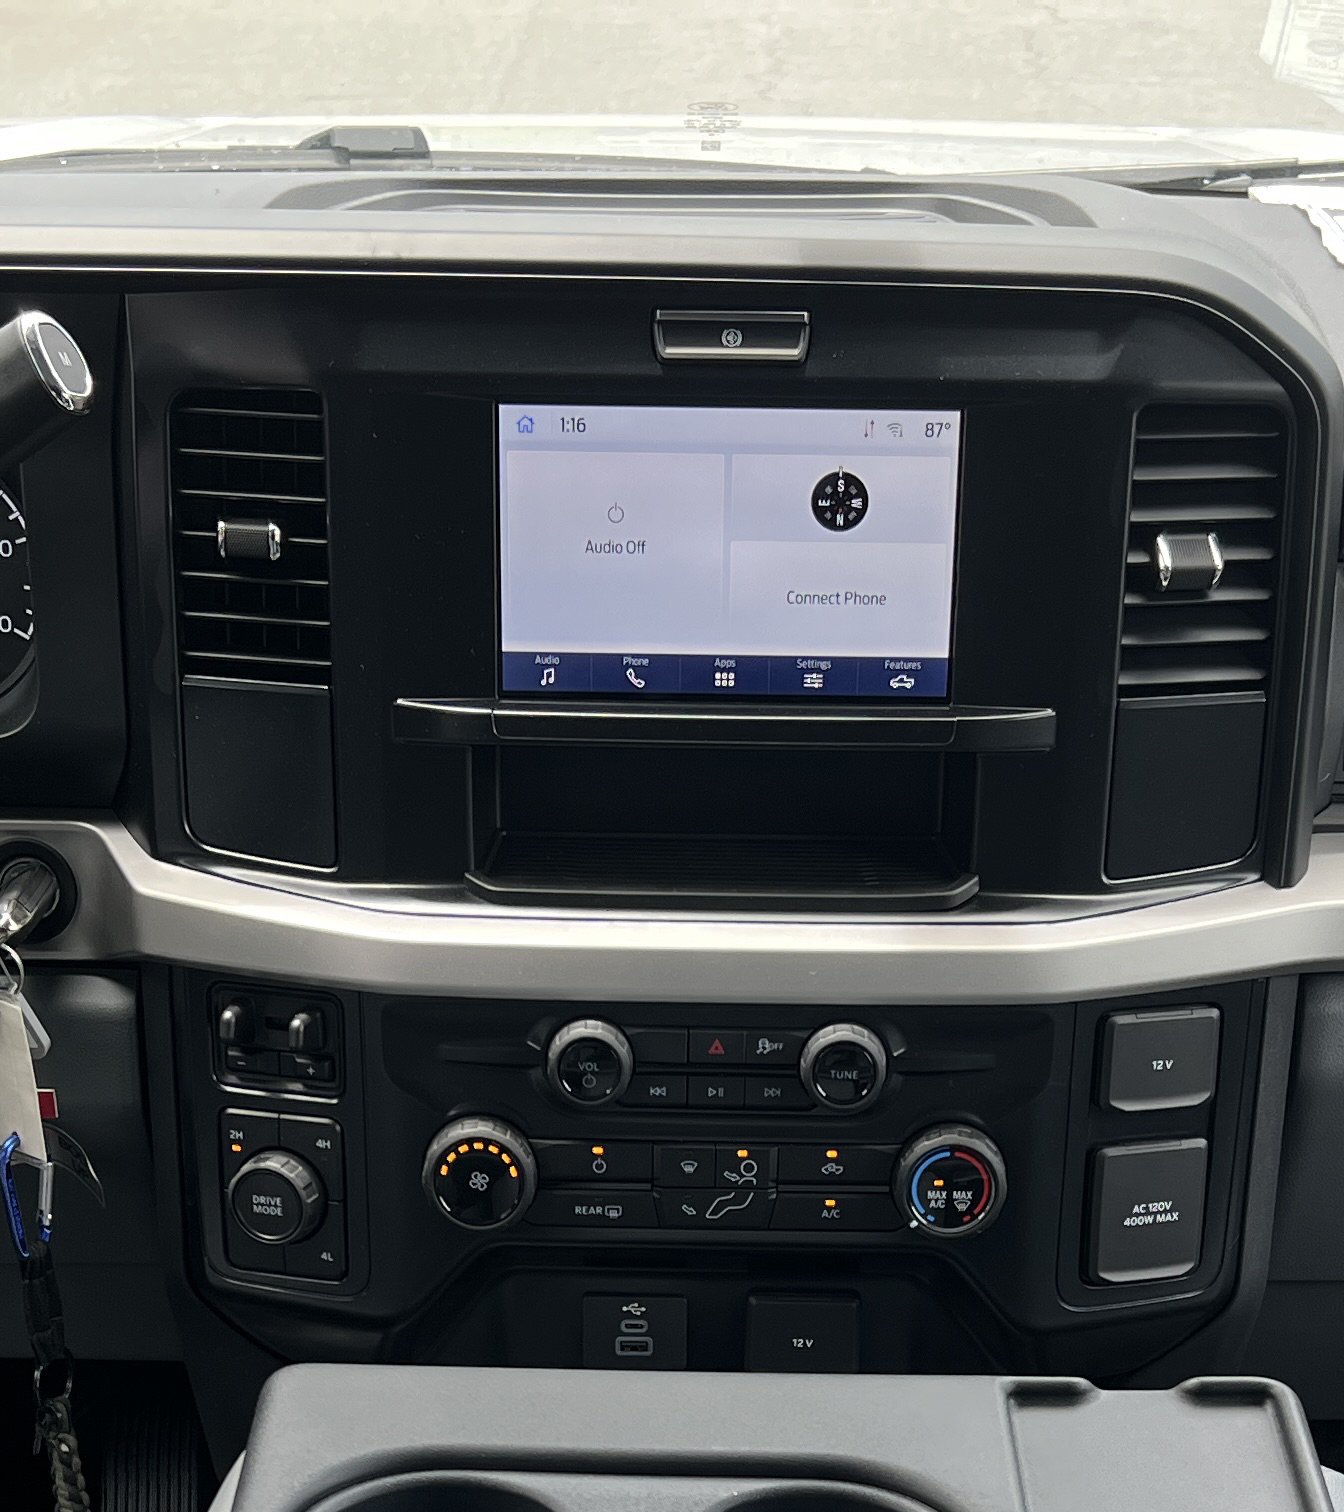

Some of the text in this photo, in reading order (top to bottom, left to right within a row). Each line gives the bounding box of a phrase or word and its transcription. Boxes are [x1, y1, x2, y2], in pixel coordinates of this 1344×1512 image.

[560, 417, 587, 434] 1:16
[925, 422, 952, 438] 87°
[837, 479, 845, 492] S
[584, 540, 646, 555] Audio Off
[786, 590, 887, 607] Connect Phone
[535, 654, 560, 666] Audio
[623, 656, 649, 667] Phone
[715, 657, 736, 670] Apps
[796, 658, 832, 671] Settings
[884, 659, 922, 671] Features
[768, 1041, 783, 1051] OFF
[578, 1061, 599, 1072] VOL
[1152, 1060, 1174, 1070] 12 V
[830, 1069, 859, 1080] TUNE
[229, 1130, 244, 1140] 2H
[316, 1139, 332, 1150] 4H
[252, 1195, 283, 1206] DRIVE
[927, 1190, 947, 1200] MAX
[952, 1190, 973, 1200] MAX
[929, 1200, 946, 1209] A/C
[1132, 1201, 1173, 1214] AC 120V
[252, 1205, 284, 1217] MODE
[575, 1205, 603, 1216] REAR
[822, 1208, 841, 1219] A/C
[1123, 1212, 1179, 1227] 400W MAX
[321, 1252, 334, 1262] 4L
[792, 1338, 814, 1348] 12 V
